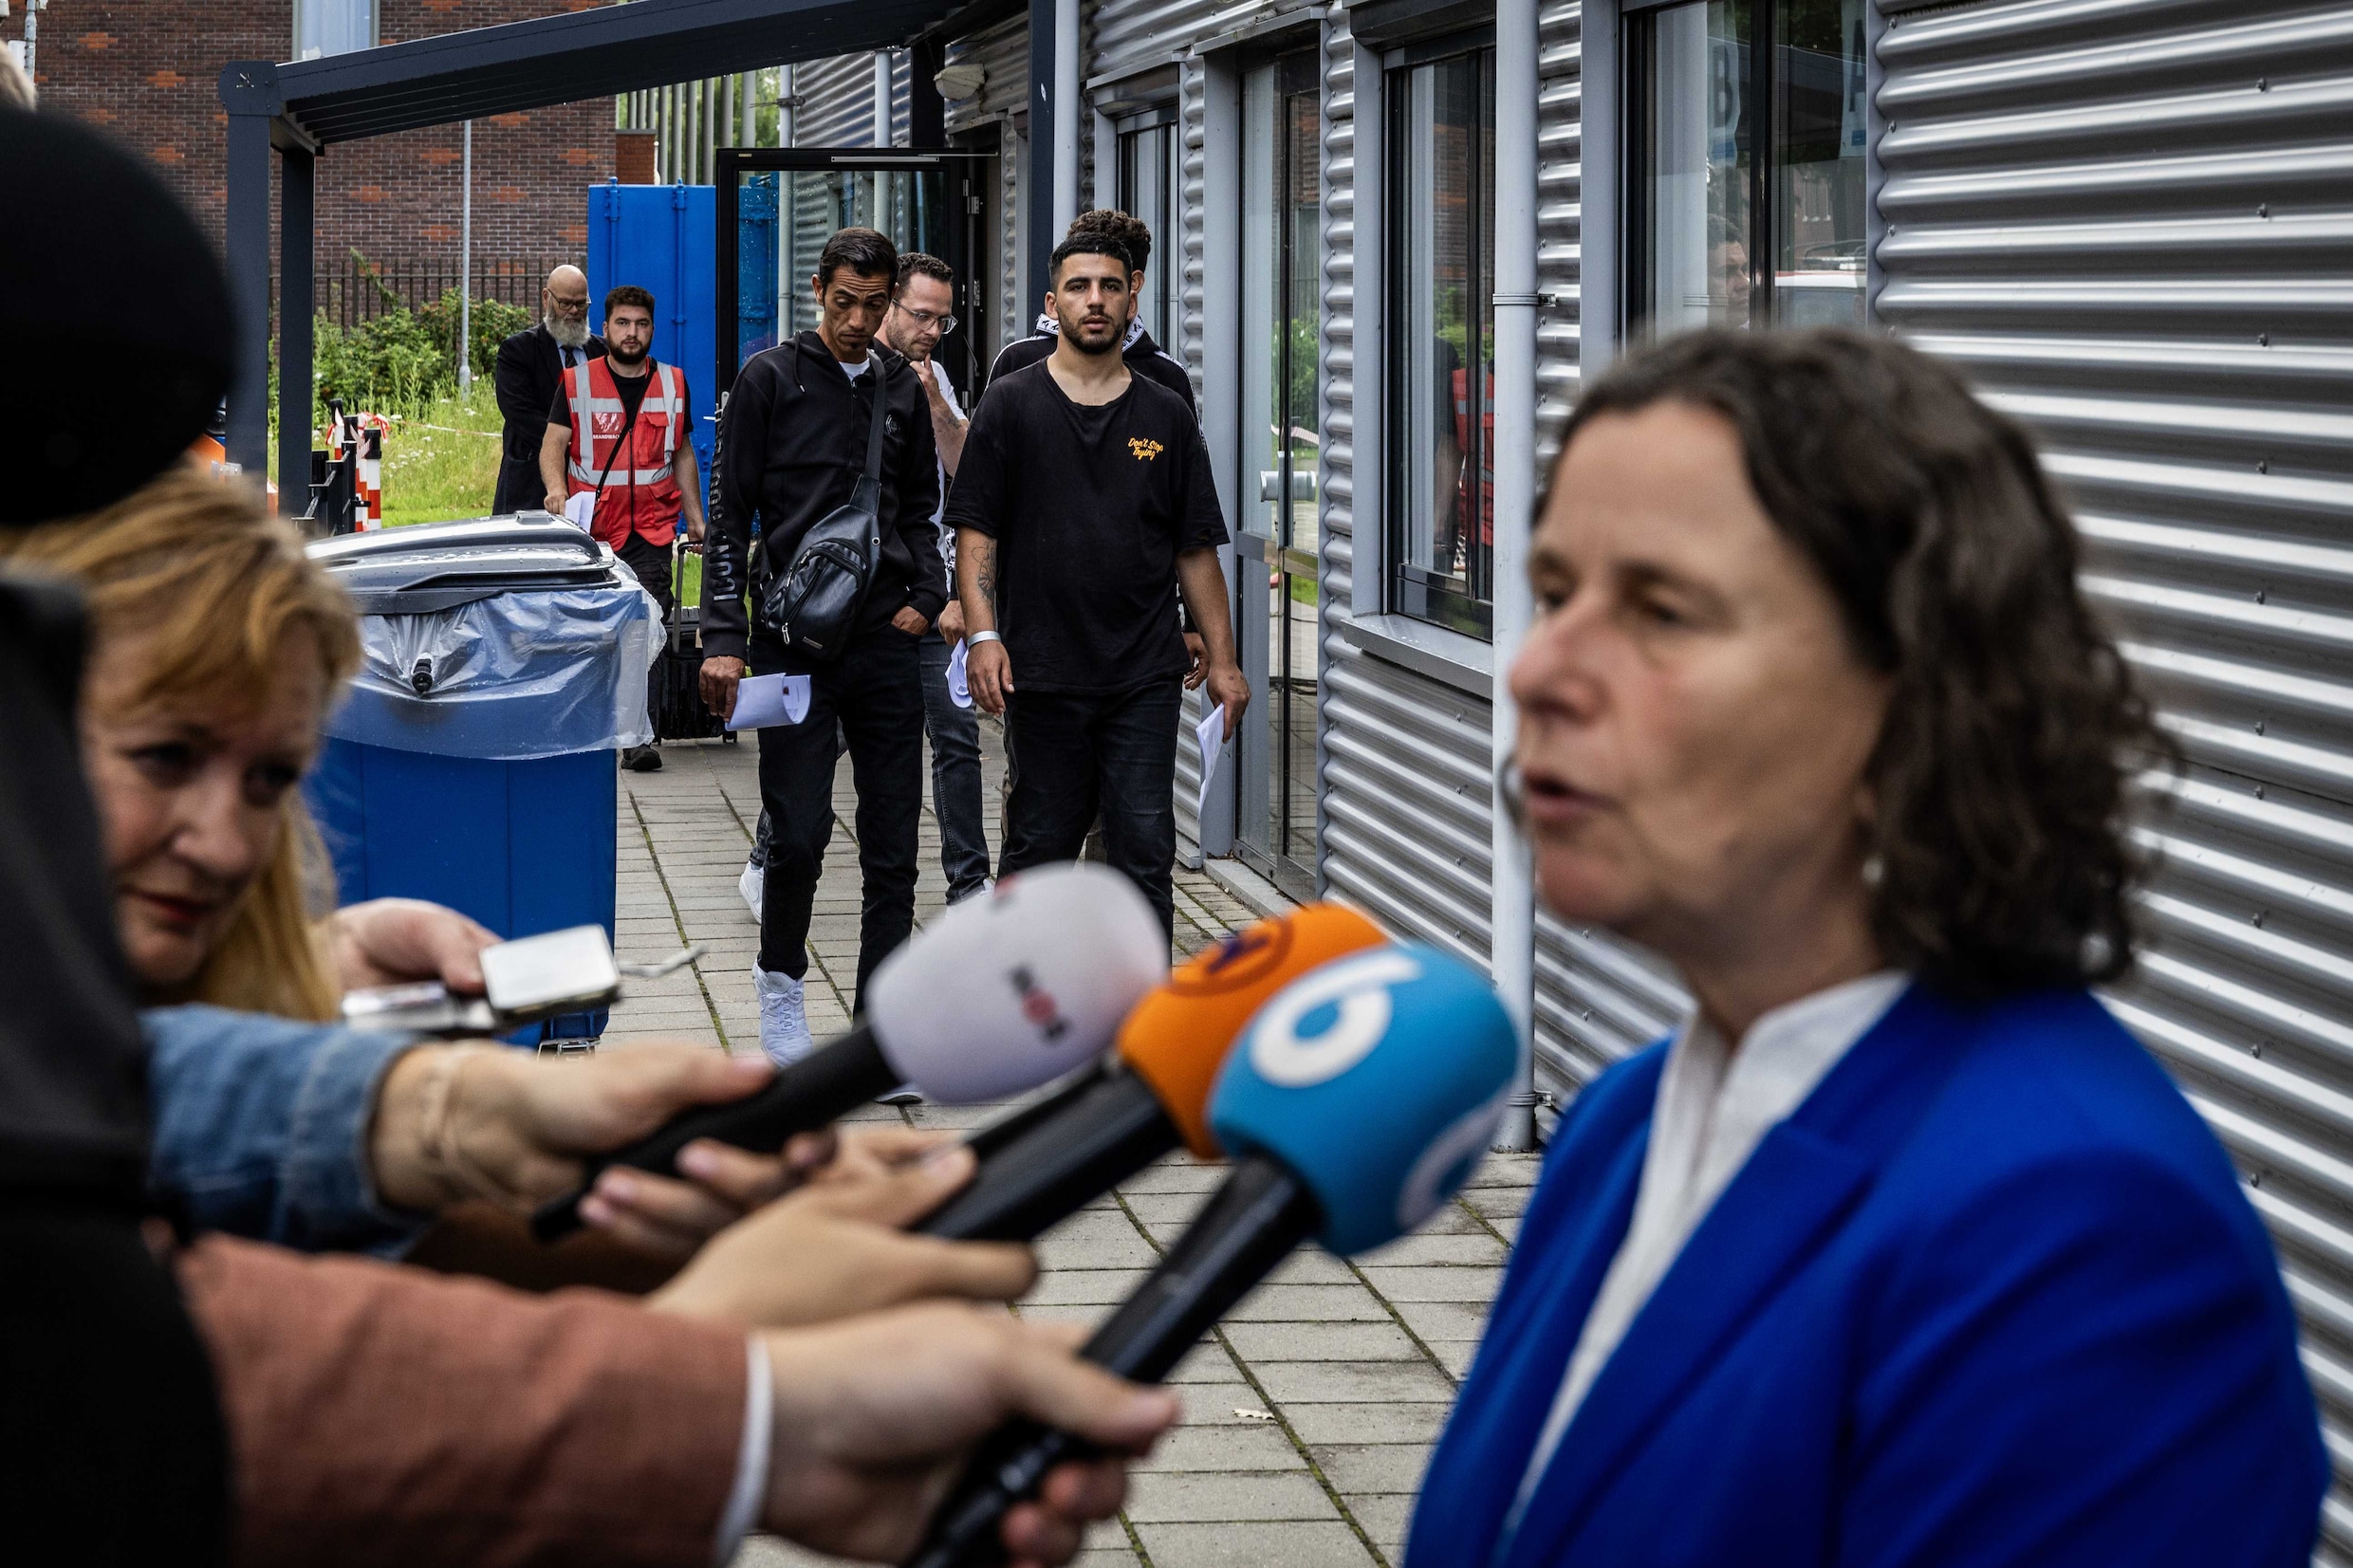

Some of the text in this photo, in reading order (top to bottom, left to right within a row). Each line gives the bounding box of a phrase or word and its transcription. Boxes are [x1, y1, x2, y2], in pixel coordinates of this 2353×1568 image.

[1128, 437, 1148, 448] Don't
[1132, 447, 1157, 461] Trying
[1247, 948, 1420, 1089] 6
